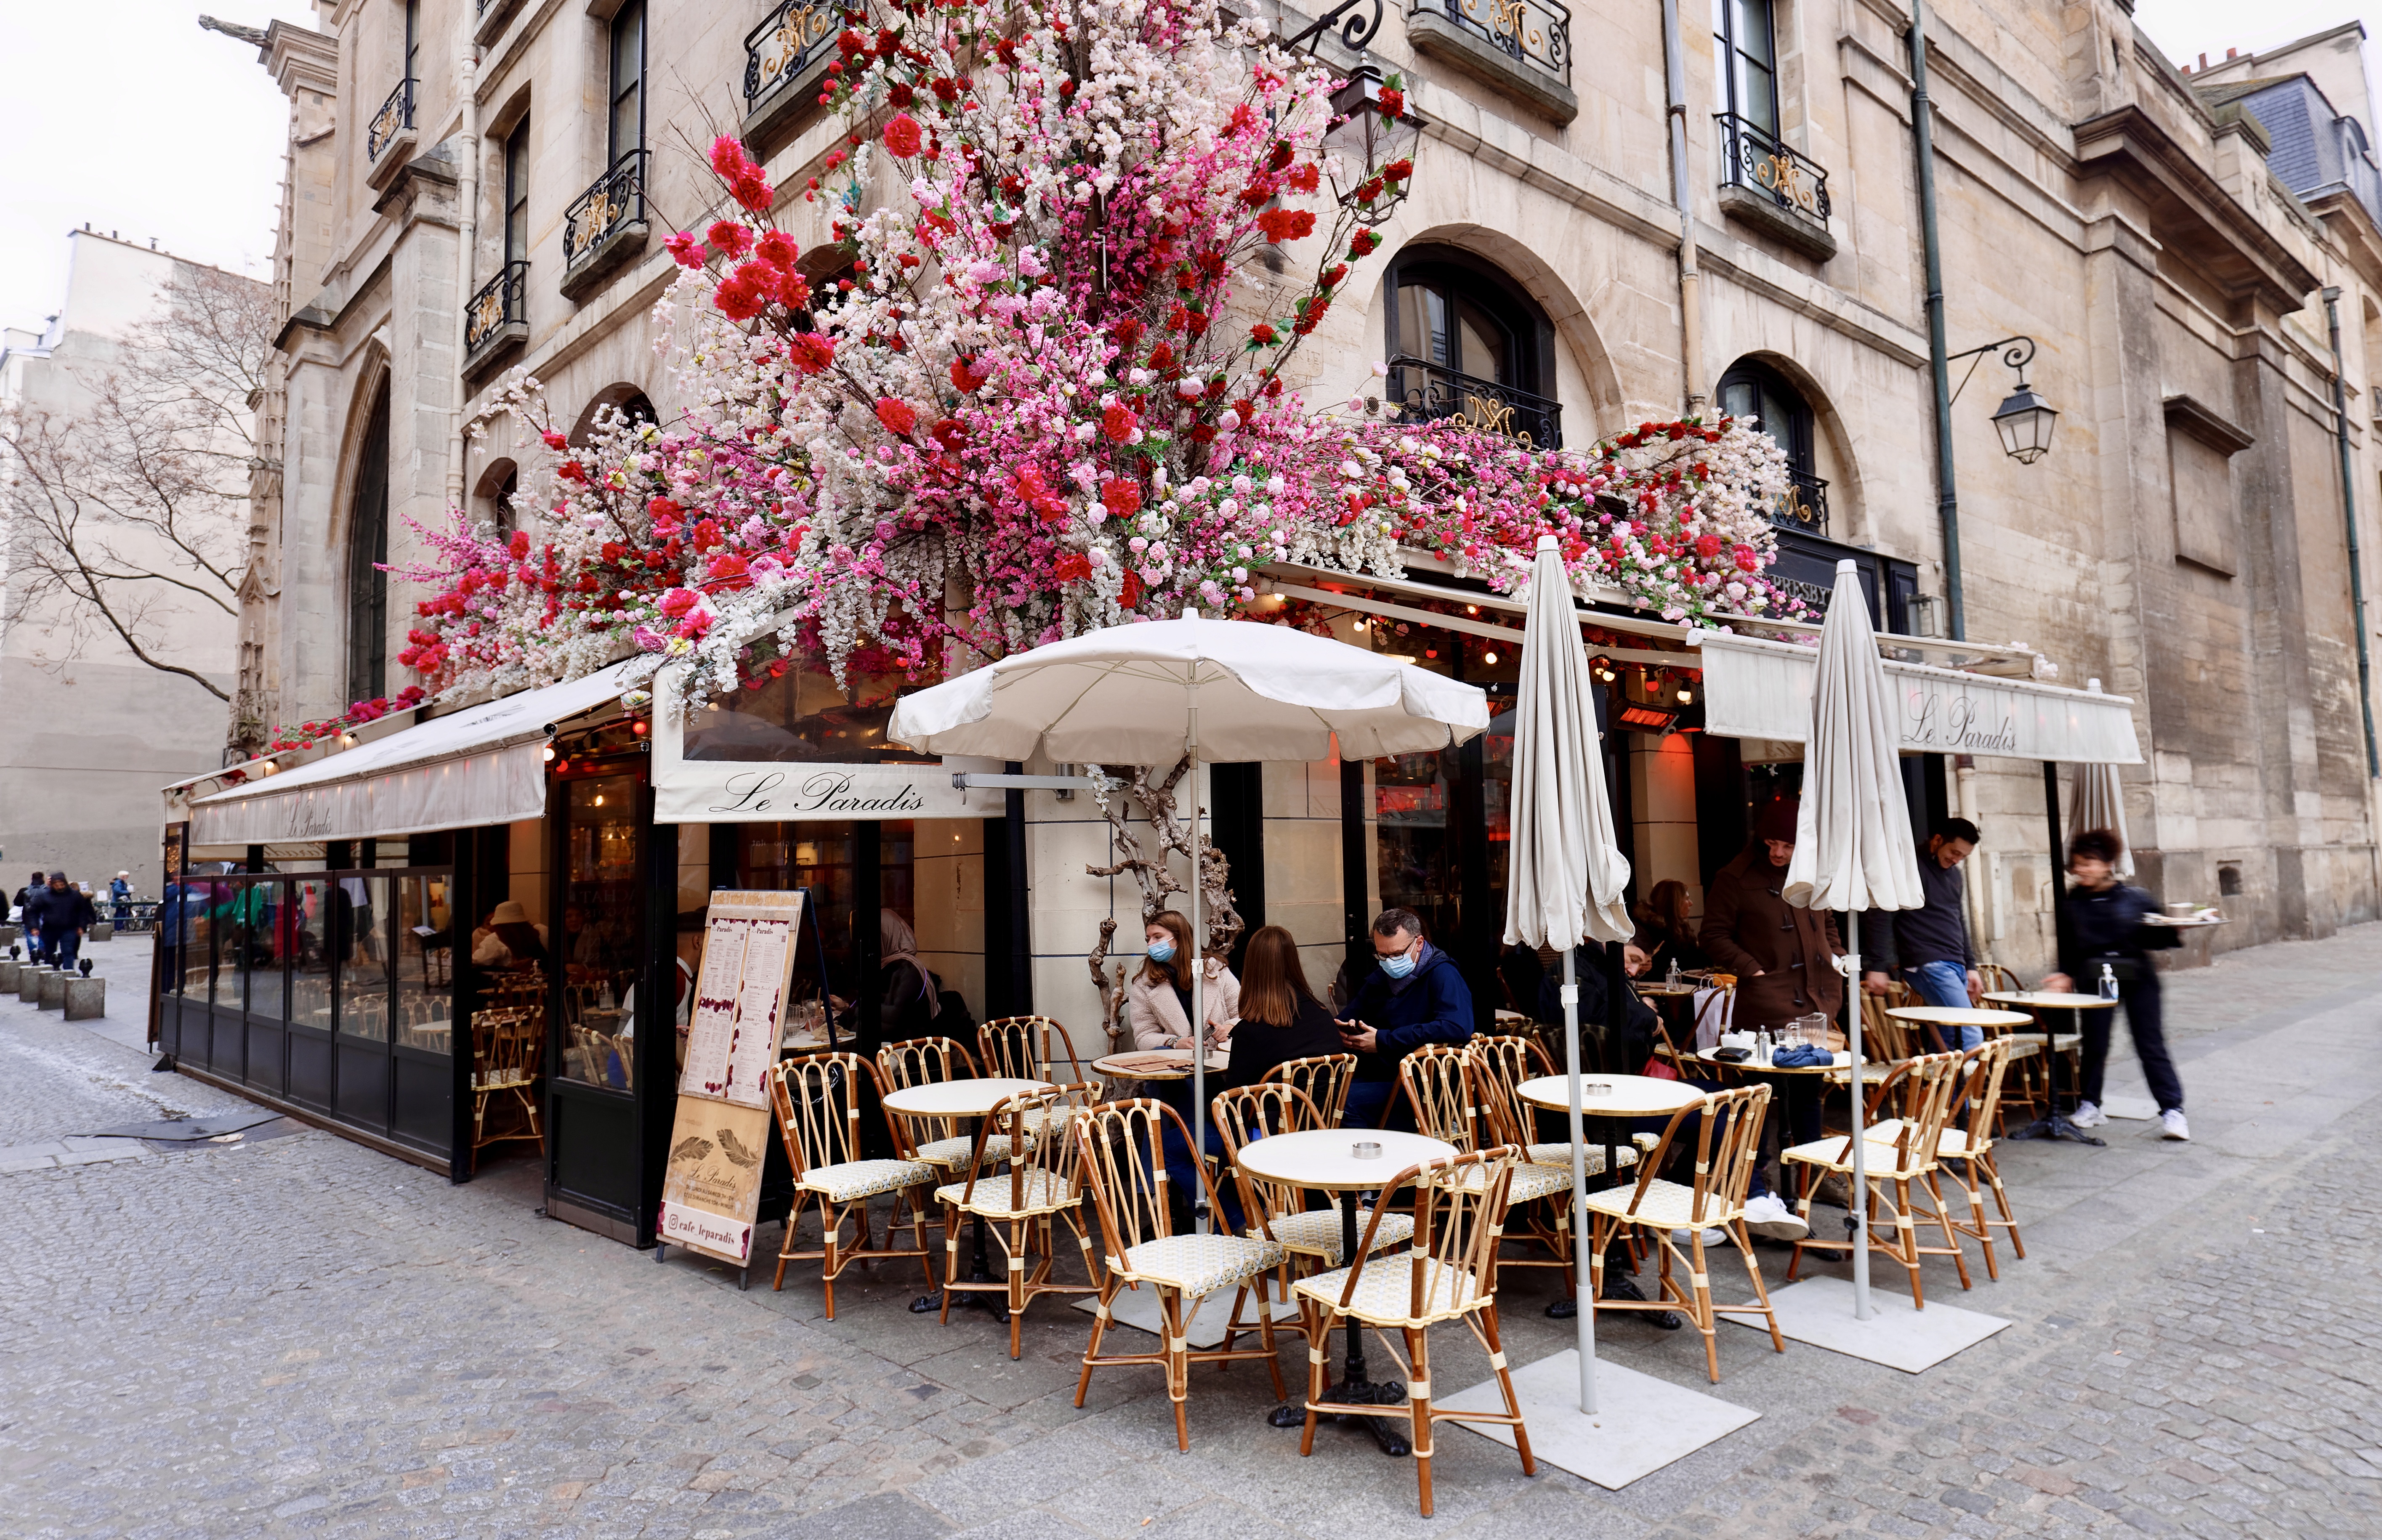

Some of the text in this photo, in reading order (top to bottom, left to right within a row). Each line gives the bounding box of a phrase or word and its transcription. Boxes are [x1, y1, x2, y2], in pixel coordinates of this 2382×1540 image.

[1902, 692, 2016, 750] Le Paradis
[709, 772, 924, 812] Le Paradis
[286, 799, 332, 837] Le Paradis
[687, 1162, 736, 1189] Le Paradis
[679, 1221, 735, 1245] cafe_leparadis
